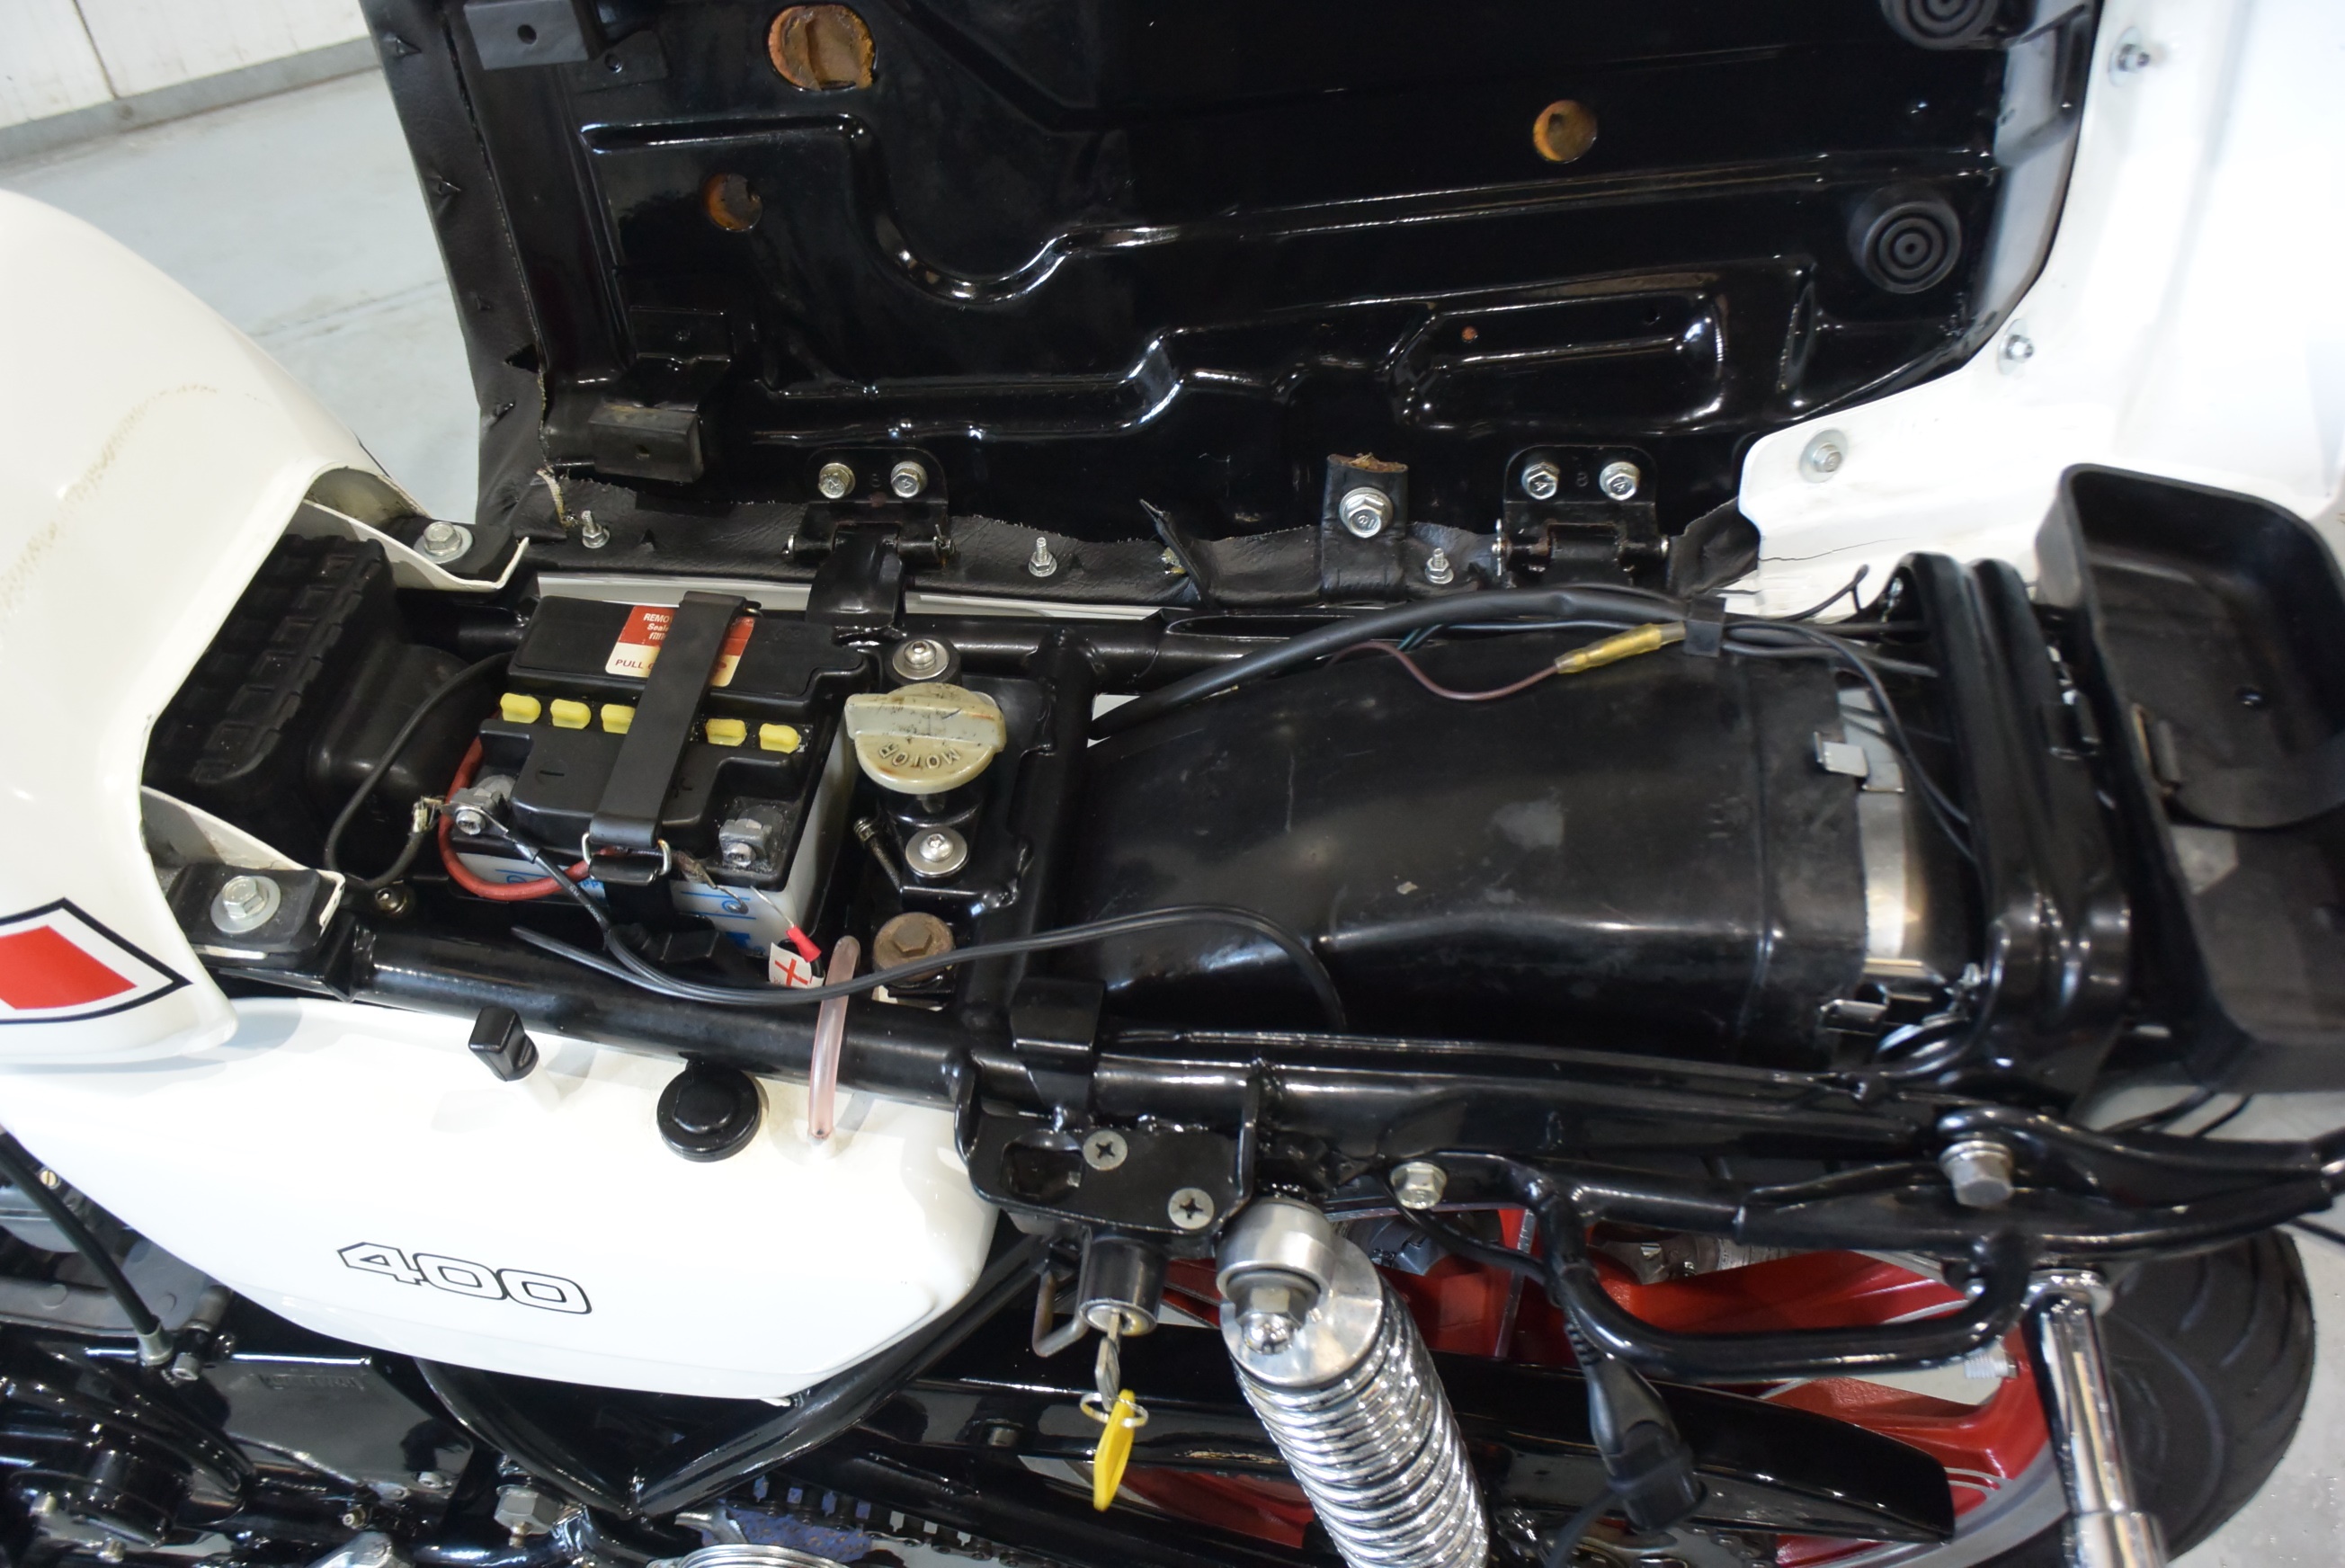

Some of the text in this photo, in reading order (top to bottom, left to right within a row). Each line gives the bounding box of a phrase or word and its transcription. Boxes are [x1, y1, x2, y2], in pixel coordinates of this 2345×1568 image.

[615, 659, 644, 669] PULL
[878, 742, 961, 769] MOTOR
[337, 1241, 592, 1314] 400
